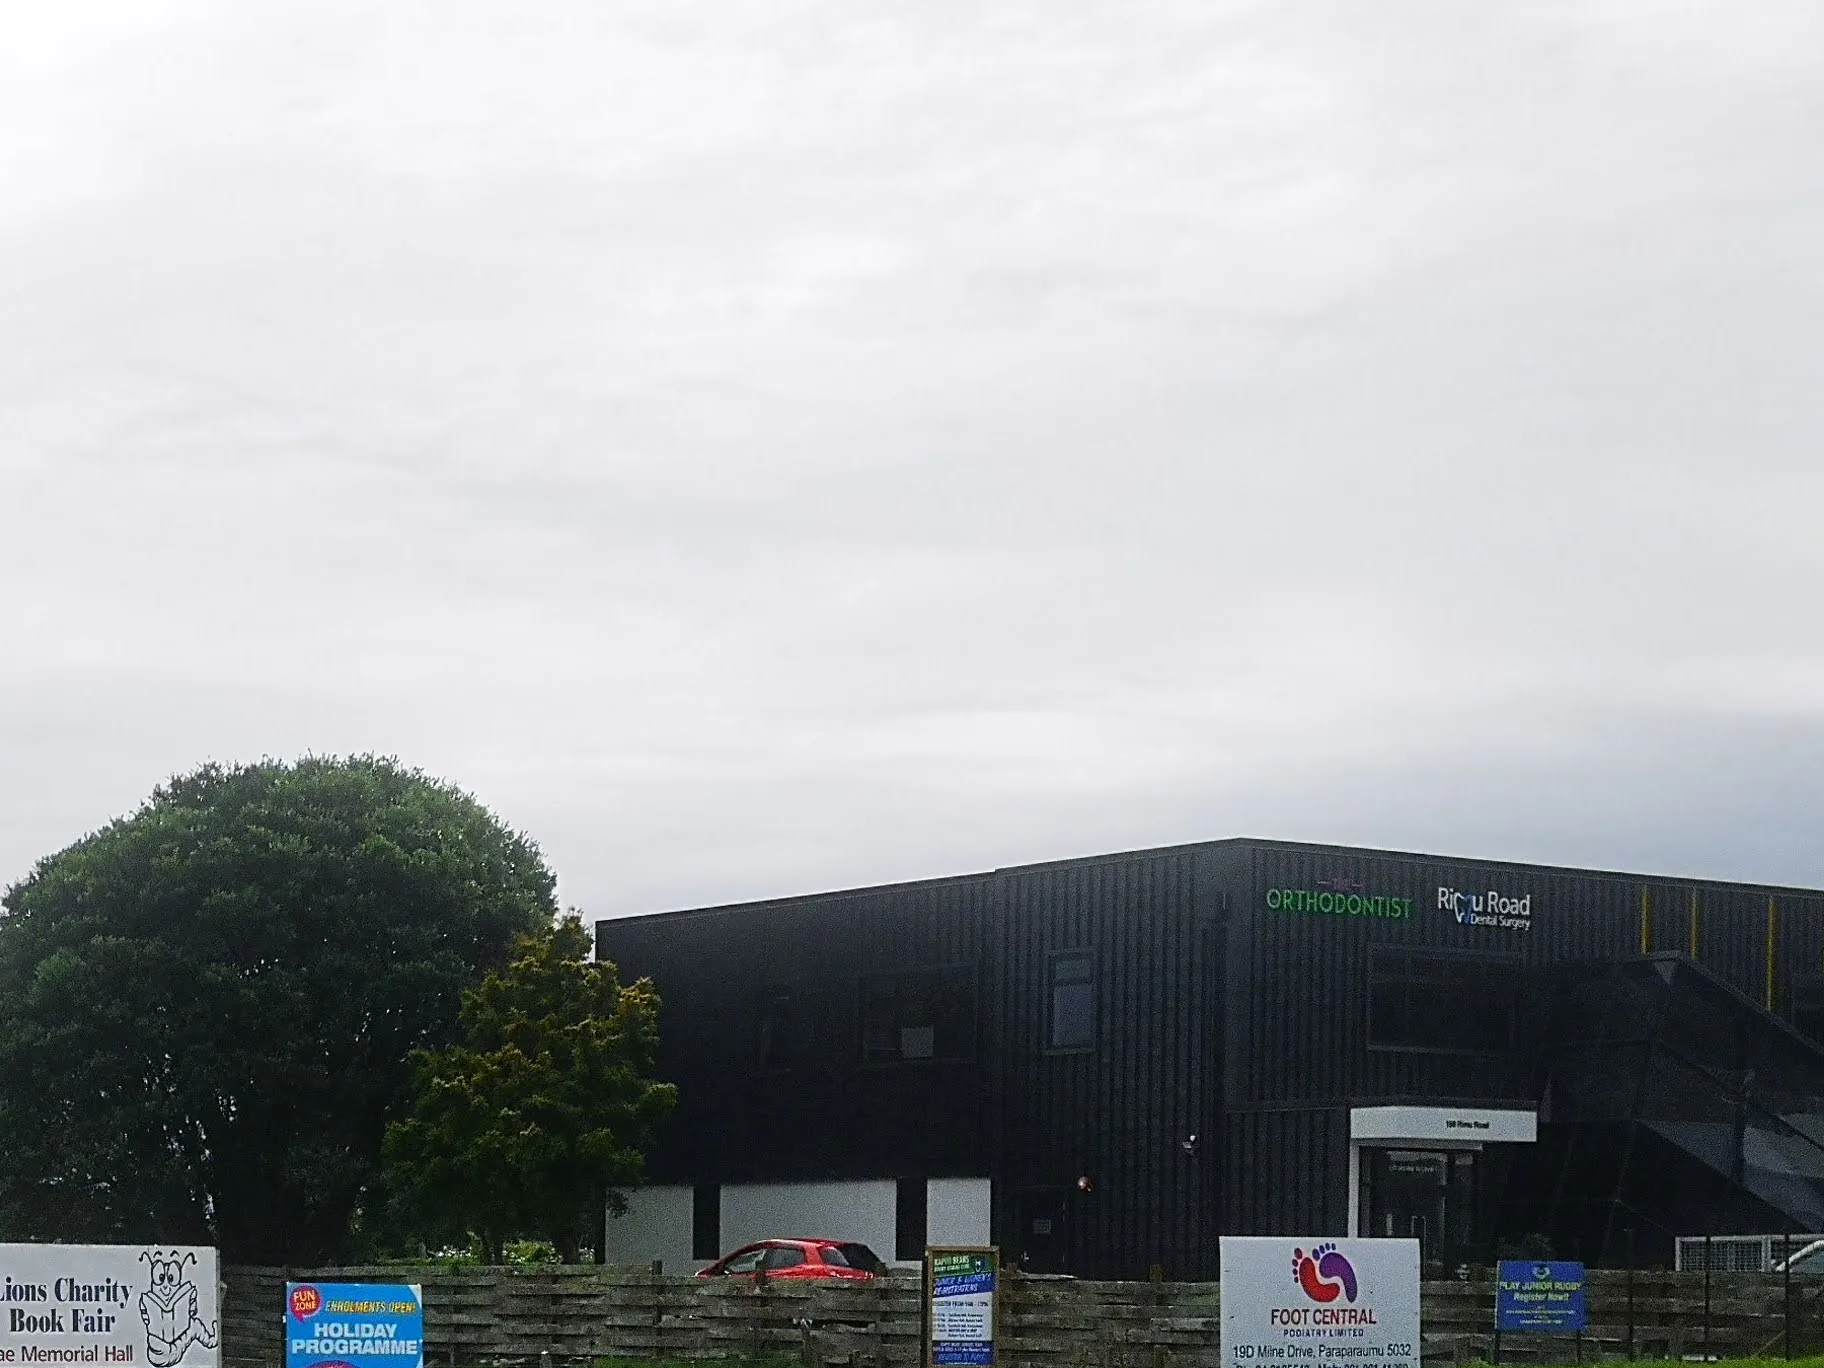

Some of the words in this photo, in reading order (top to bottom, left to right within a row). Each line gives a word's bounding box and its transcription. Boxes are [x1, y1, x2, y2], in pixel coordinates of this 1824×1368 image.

[1267, 889, 1412, 919] ORTHODONTIST
[1488, 891, 1531, 916] Road
[1471, 913, 1498, 926] Dental
[1499, 916, 1531, 931] Surgery
[1474, 1121, 1490, 1129] Road
[55, 1278, 133, 1309] Charity
[1499, 1282, 1520, 1290] PLAY
[1522, 1282, 1553, 1291] JUNIOR
[1555, 1282, 1581, 1291] RUGBY
[294, 1290, 316, 1302] FUN
[295, 1301, 316, 1311] ZONE
[326, 1301, 386, 1313] ENROLMENTS
[10, 1309, 64, 1333] Book
[72, 1309, 116, 1333] Fair
[1271, 1309, 1310, 1325] FOOT
[1313, 1309, 1377, 1325] CENTRAL
[314, 1323, 397, 1338] HOLIDAY
[1284, 1329, 1326, 1337] PODIATRY
[1329, 1329, 1364, 1337] LIMITED
[22, 1346, 98, 1362] Memorial
[105, 1345, 133, 1362] Hall
[292, 1339, 418, 1355] PROGRAMME
[1234, 1345, 1255, 1358] 19D
[1258, 1345, 1284, 1359] Milne
[1288, 1345, 1316, 1359] Drive,
[1319, 1345, 1384, 1359] Paraparaumu
[1387, 1344, 1411, 1357] 5032
